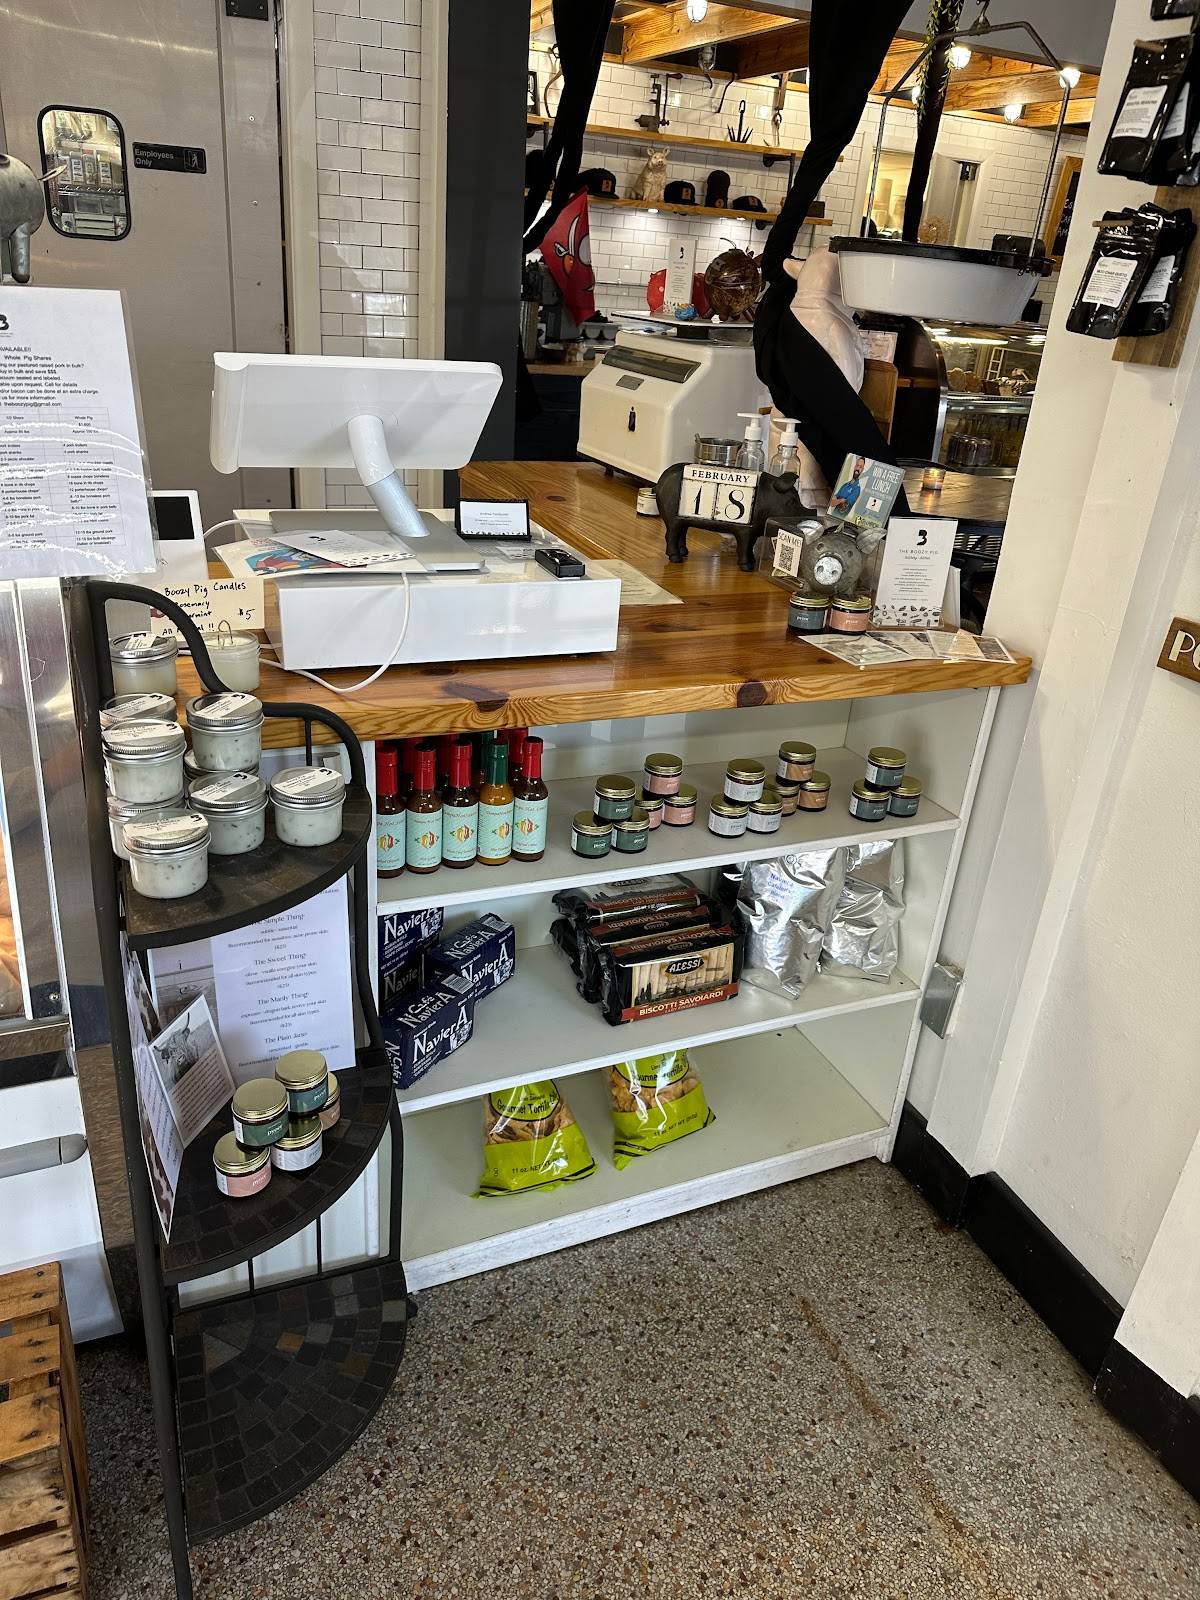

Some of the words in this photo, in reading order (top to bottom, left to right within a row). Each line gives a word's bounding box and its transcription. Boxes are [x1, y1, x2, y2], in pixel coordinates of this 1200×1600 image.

[134, 149, 174, 160] Employees
[135, 157, 153, 167] Only
[692, 469, 750, 483] FEBRUARY
[886, 470, 901, 484] FREE
[872, 478, 892, 494] LUNCH
[693, 485, 703, 515] 1
[724, 489, 745, 520] 8
[778, 532, 793, 544] SCAN
[164, 587, 190, 597] Boozy
[194, 584, 208, 598] Pig
[214, 582, 246, 591] Candles
[1168, 630, 1200, 670] P
[263, 916, 286, 924] Simple
[286, 913, 305, 922] Thing
[384, 906, 438, 945] NavierA
[445, 930, 496, 960] NavierA
[454, 934, 477, 949] Café
[267, 956, 286, 964] Sweet
[288, 952, 306, 960] Thing
[462, 942, 510, 984] NavierA
[668, 958, 702, 974] ALESSI
[270, 995, 289, 1003] Manly
[408, 995, 436, 1014] Café
[639, 1002, 678, 1016] BISCOTTI
[678, 990, 724, 1006] SAVOIARDI
[396, 992, 456, 1029] NavierA
[277, 1034, 292, 1042] Plain
[412, 1005, 468, 1064] NavierA
